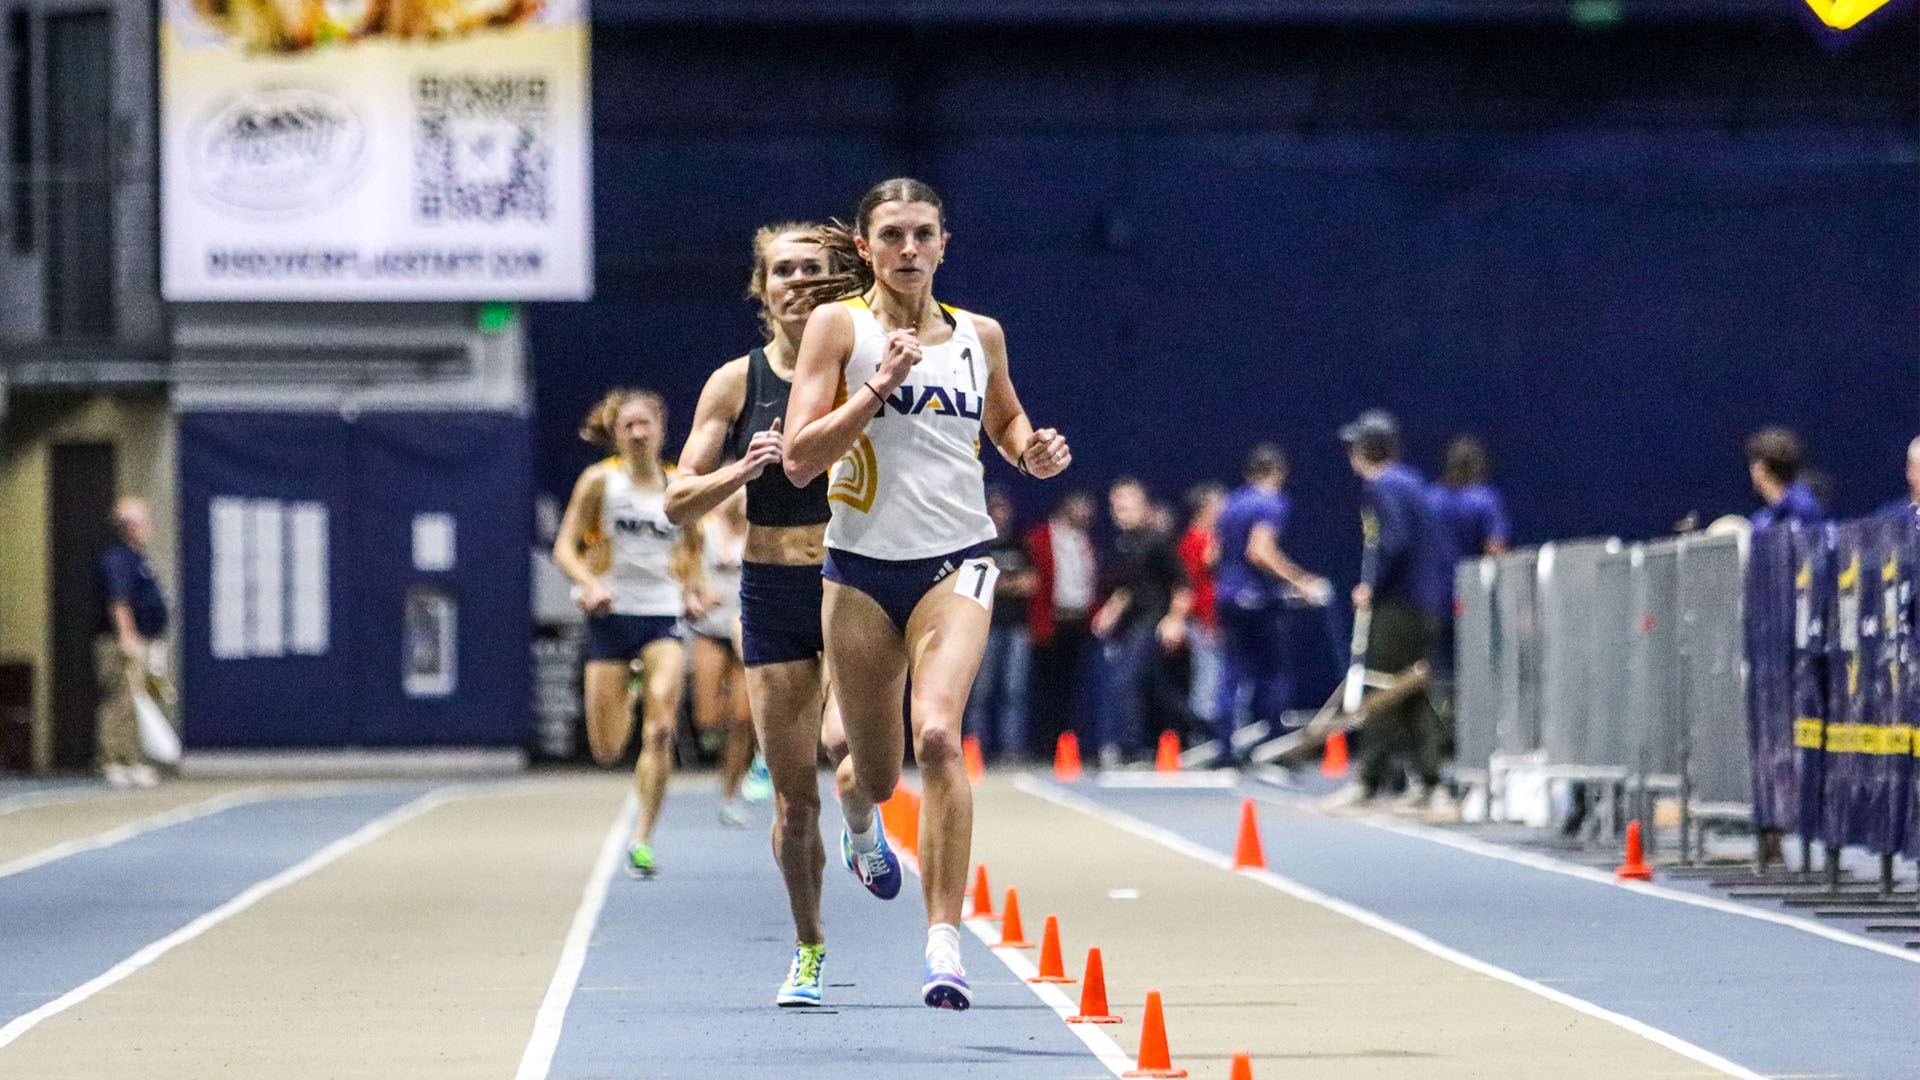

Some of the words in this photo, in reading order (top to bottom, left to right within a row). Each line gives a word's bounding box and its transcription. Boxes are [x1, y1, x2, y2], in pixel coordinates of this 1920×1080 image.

[960, 347, 977, 393] 1
[873, 386, 983, 421] NAU
[973, 563, 989, 599] 1
